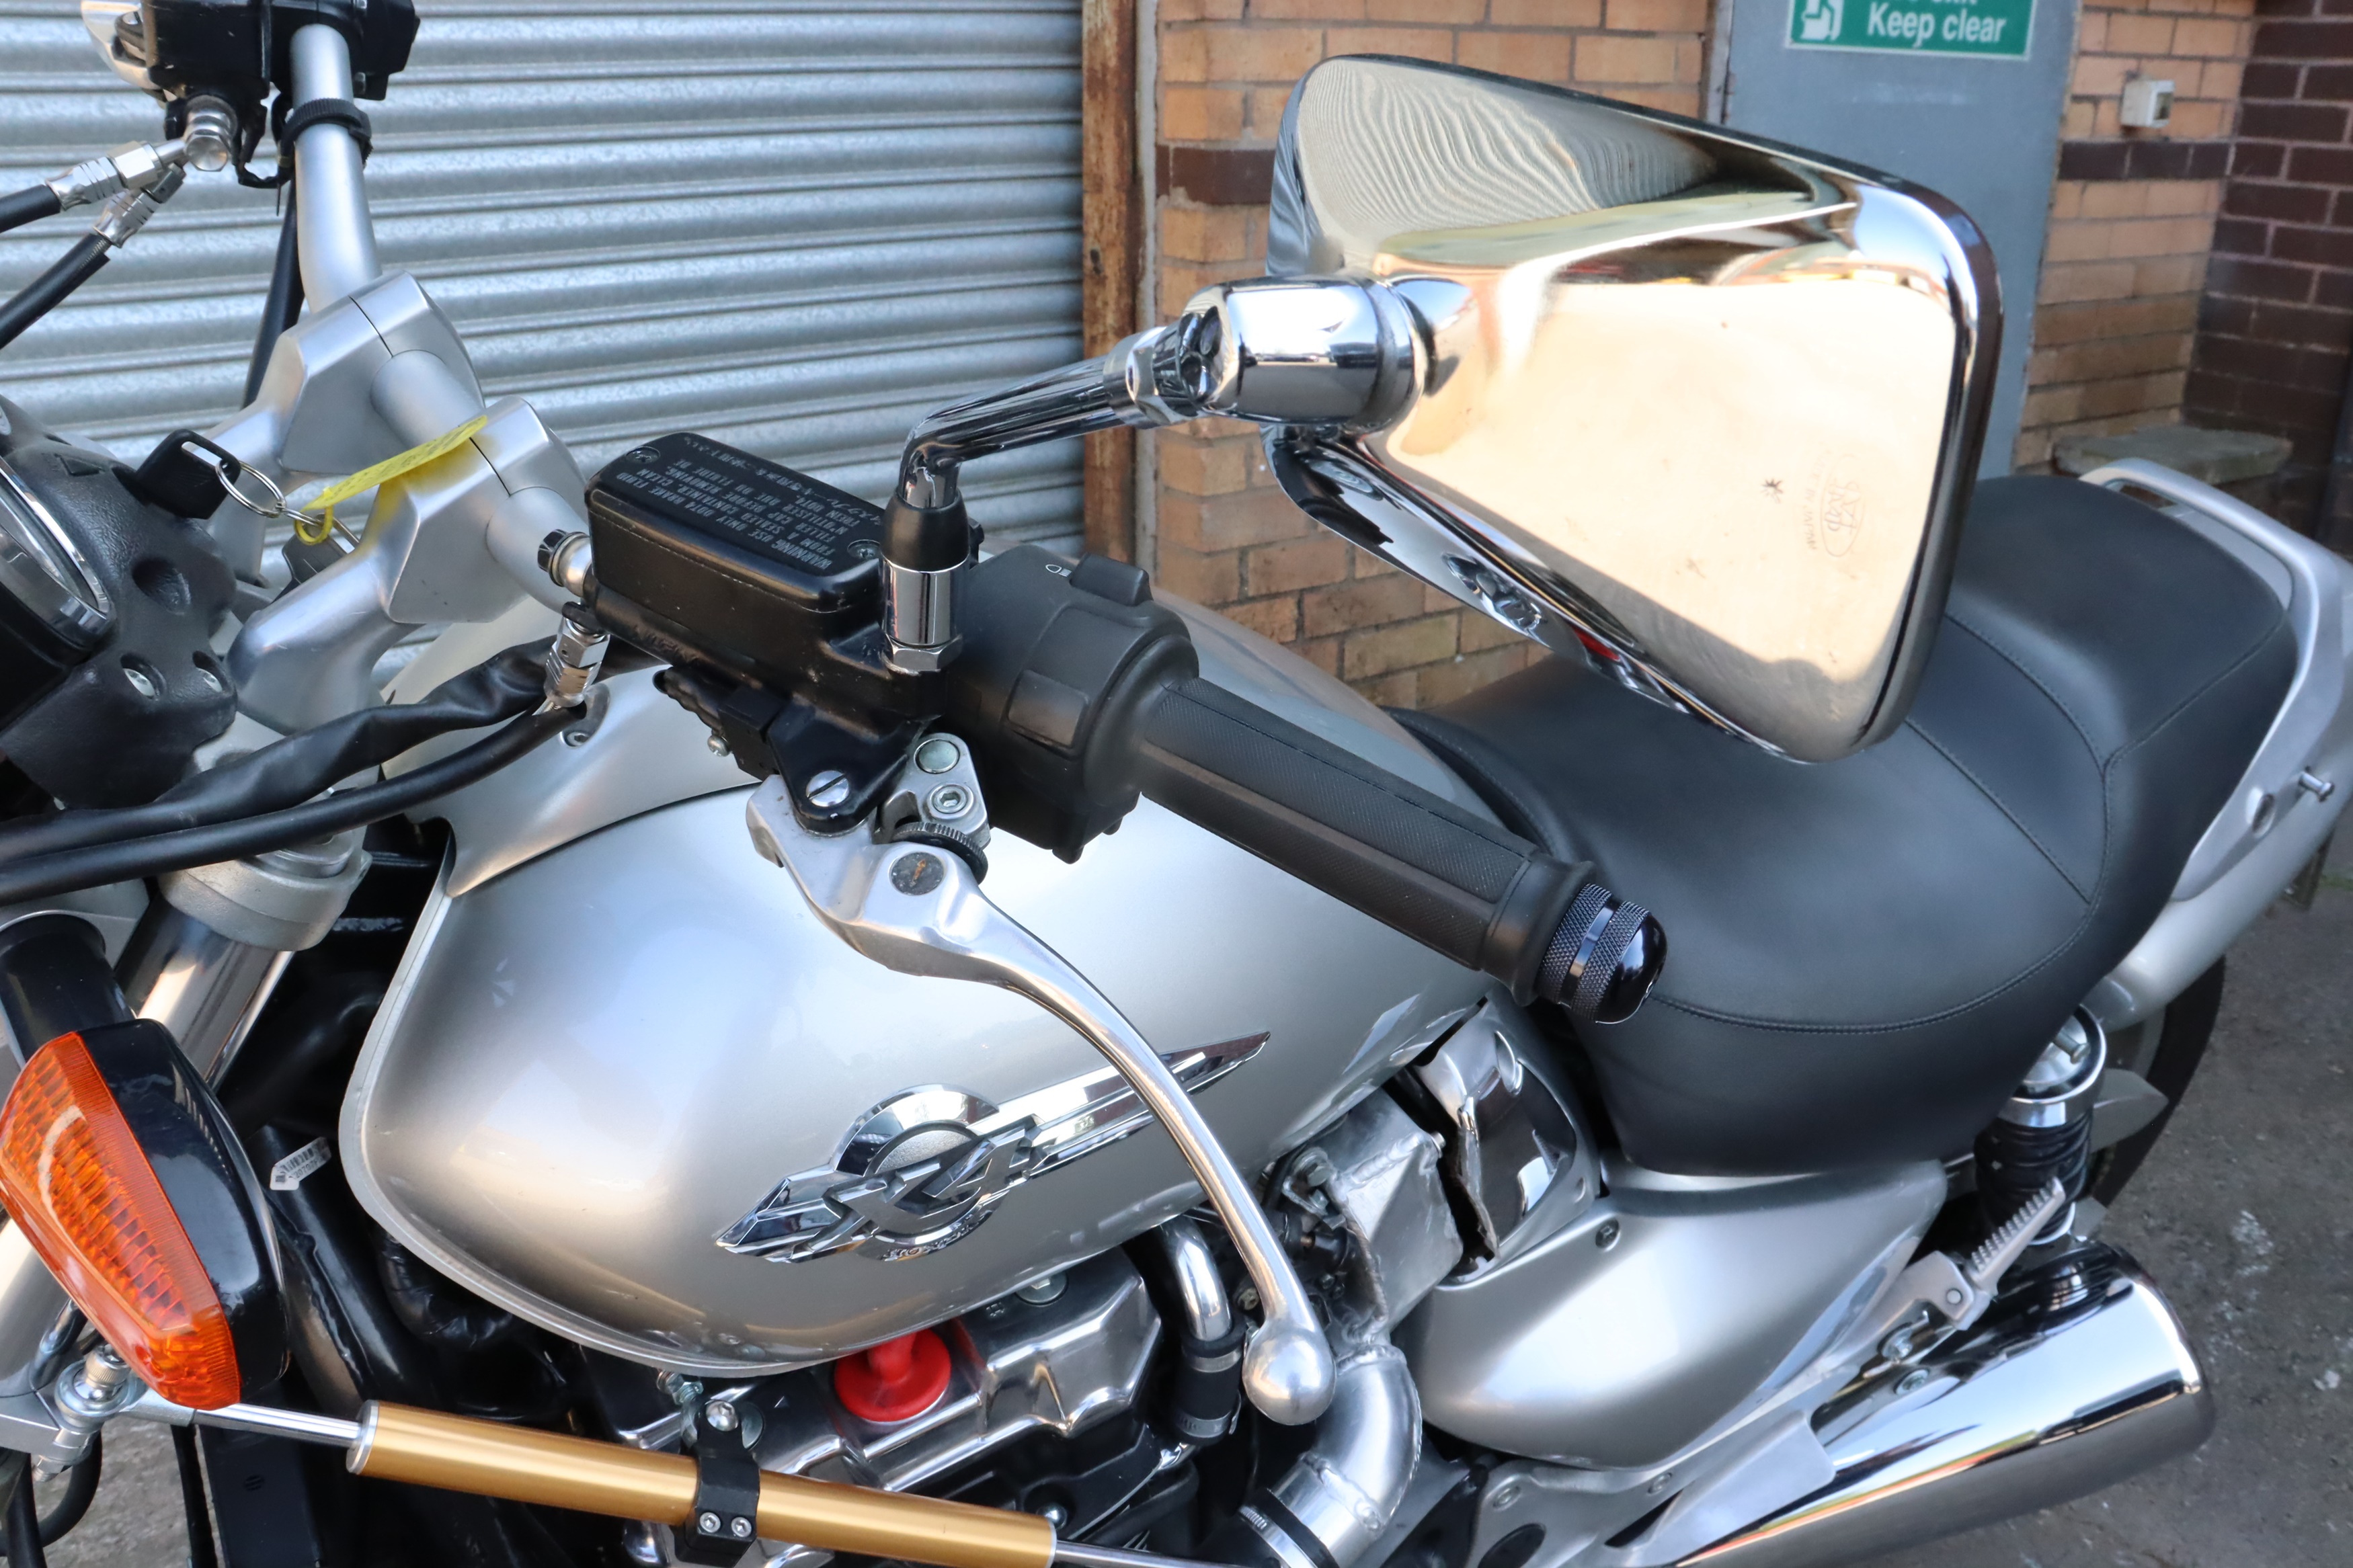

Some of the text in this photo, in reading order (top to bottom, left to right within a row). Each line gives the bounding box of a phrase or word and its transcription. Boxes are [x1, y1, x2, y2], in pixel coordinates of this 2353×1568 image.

[1868, 1, 2007, 48] Keep clear
[673, 458, 692, 468] DE
[692, 466, 733, 486] FLUIDE
[734, 484, 754, 495] DU
[754, 492, 781, 505] QUE
[636, 468, 835, 555] FROM A SEALED CONTAINER. CLEAN
[665, 466, 836, 542] FILLER CAP BEFORE REMOVING.
[616, 472, 832, 569] WARNING USE ONLY DOT4 BRAKE FLUID
[825, 509, 860, 527] FREIN
